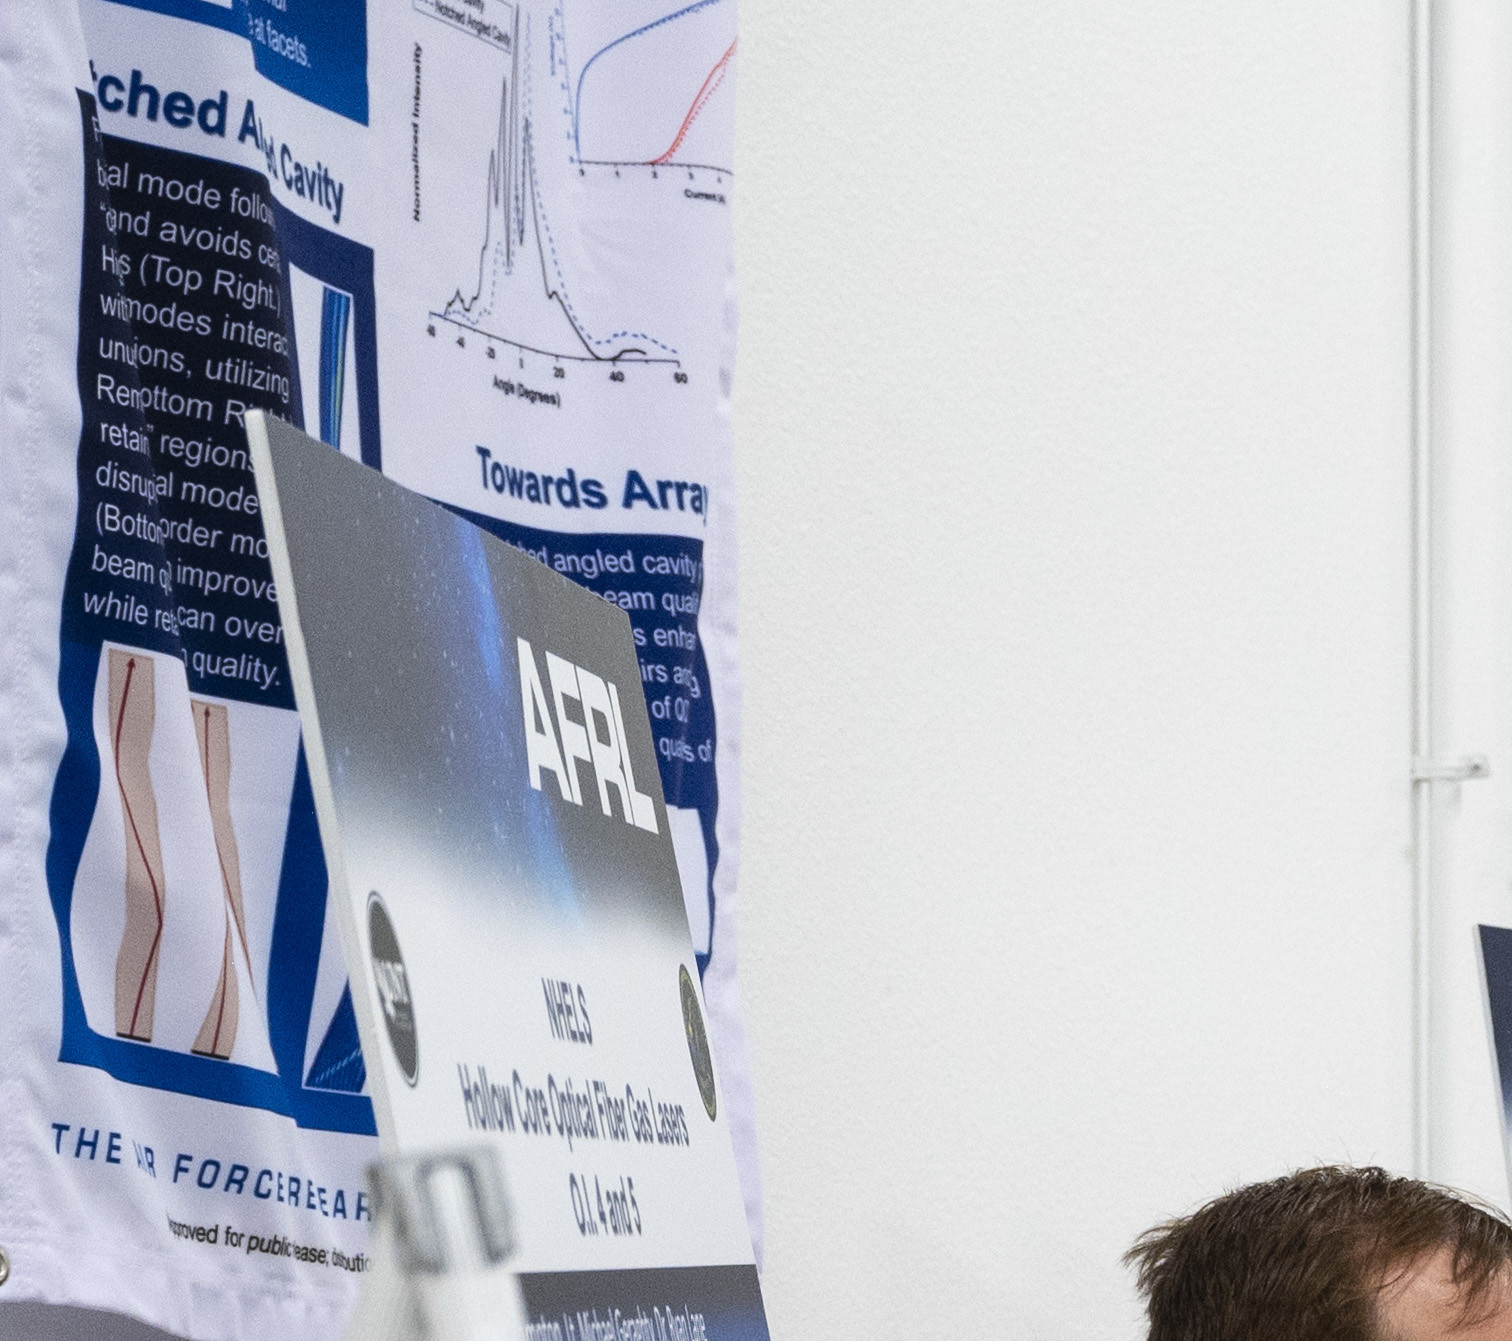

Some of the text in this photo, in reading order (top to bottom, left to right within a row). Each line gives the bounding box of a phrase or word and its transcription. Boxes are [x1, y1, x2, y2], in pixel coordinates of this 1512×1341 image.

[411, 41, 422, 118] Intensity
[90, 60, 344, 226] ched Cavity
[137, 171, 222, 210] mode
[411, 121, 421, 222] Normalized
[159, 219, 252, 260] avoids
[140, 252, 203, 295] (Top
[205, 357, 290, 403] utilizing
[476, 445, 708, 518] Towards Arra
[91, 544, 155, 584] beam
[554, 547, 636, 579] angled
[83, 590, 149, 626] while
[192, 648, 281, 690] quality.
[517, 637, 659, 835] AFRL
[541, 976, 593, 1046] NHELS
[458, 1062, 690, 1153] Hollow Core Optical Fiber Gas Lasers
[51, 1122, 122, 1164] THE
[605, 1174, 633, 1237] and
[224, 1225, 245, 1249] for
